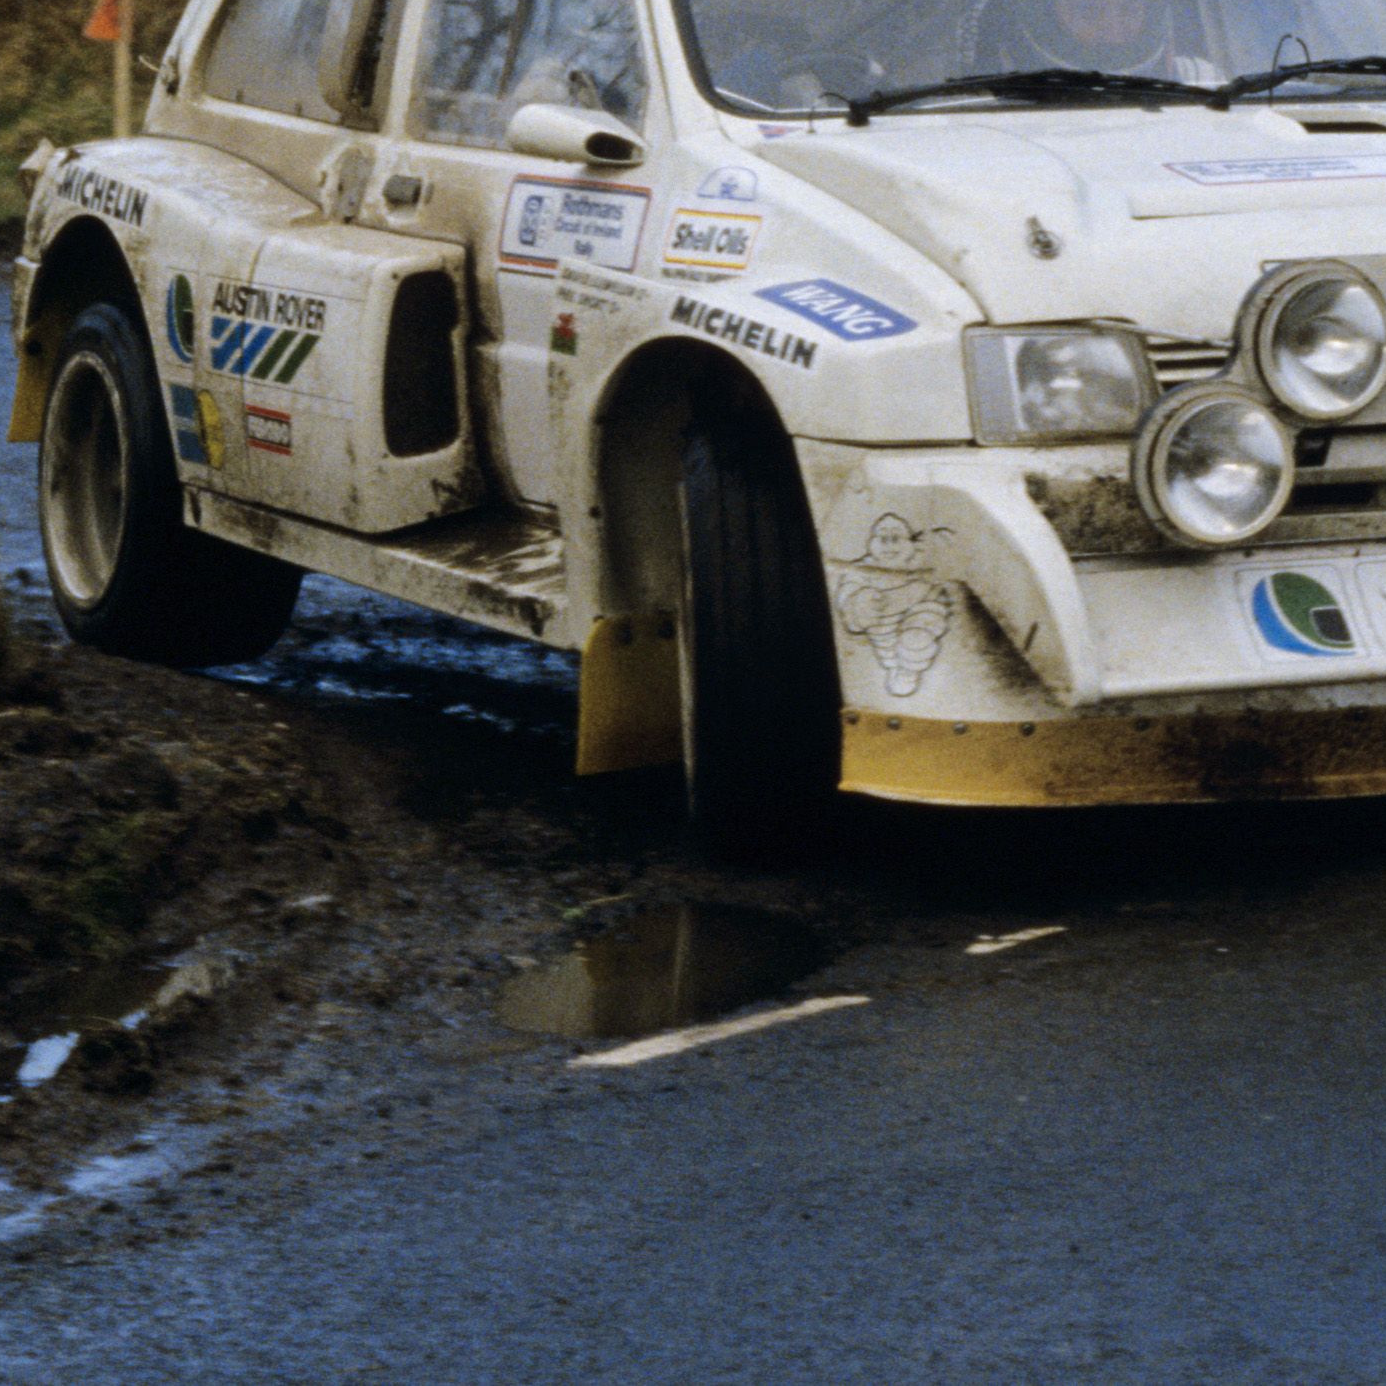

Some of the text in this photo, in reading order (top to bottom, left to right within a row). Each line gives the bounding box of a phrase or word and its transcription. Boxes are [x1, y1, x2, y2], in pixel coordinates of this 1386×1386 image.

[57, 165, 148, 227] MICHELIN
[672, 223, 716, 251] Shell
[212, 281, 326, 331] AUSTIN ROVER
[780, 284, 894, 335] WANG
[670, 295, 819, 370] MICHELIN
